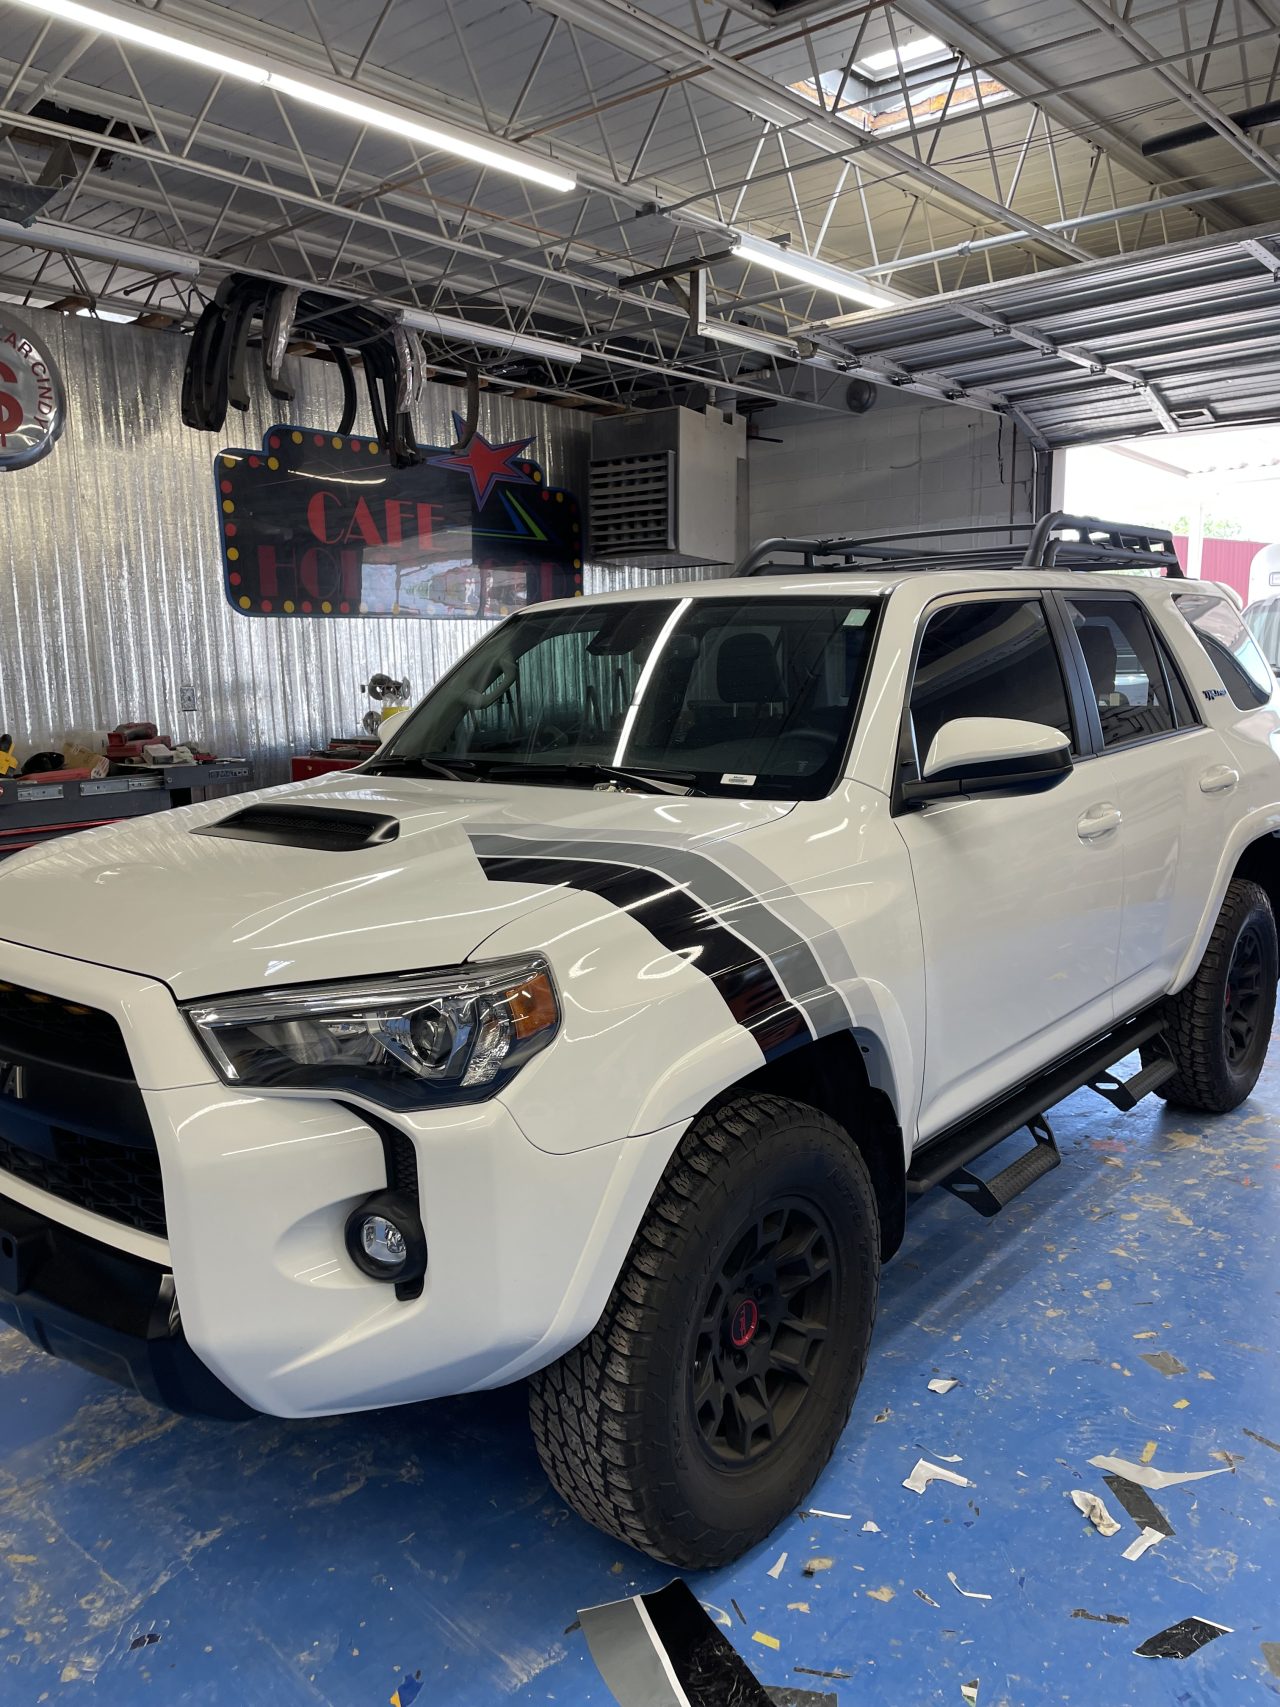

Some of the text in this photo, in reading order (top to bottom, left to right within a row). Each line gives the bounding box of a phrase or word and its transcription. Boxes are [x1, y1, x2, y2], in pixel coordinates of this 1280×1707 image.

[0, 331, 53, 430] AR CINDY
[307, 491, 447, 550] CAFE
